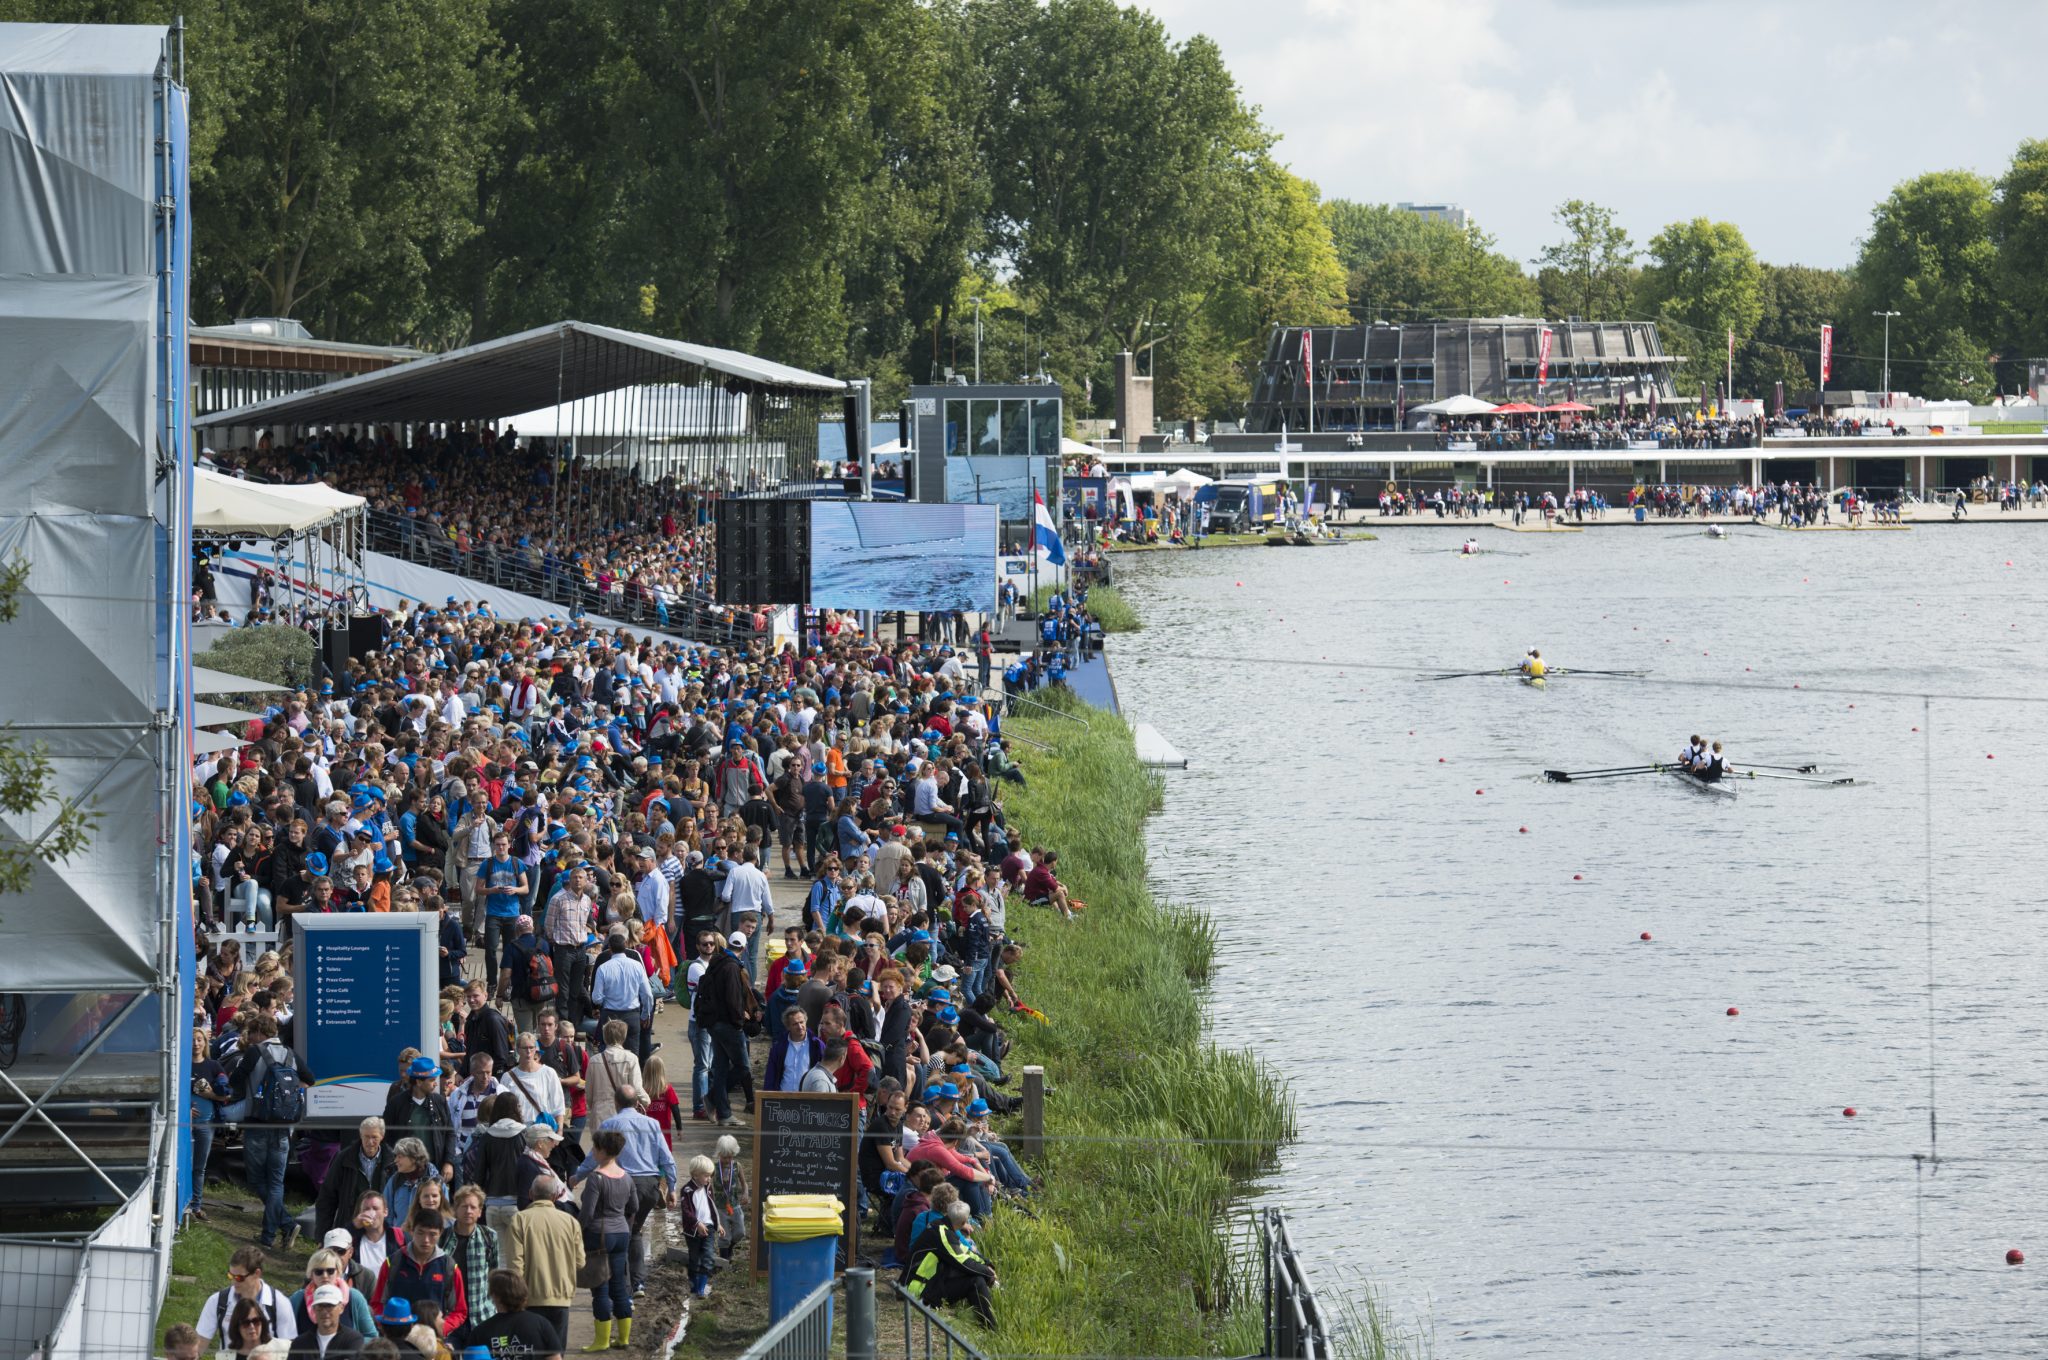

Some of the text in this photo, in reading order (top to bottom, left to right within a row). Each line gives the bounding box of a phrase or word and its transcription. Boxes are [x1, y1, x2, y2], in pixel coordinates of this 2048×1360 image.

[490, 1334, 521, 1348] BE A
[491, 1344, 534, 1357] MATCH
